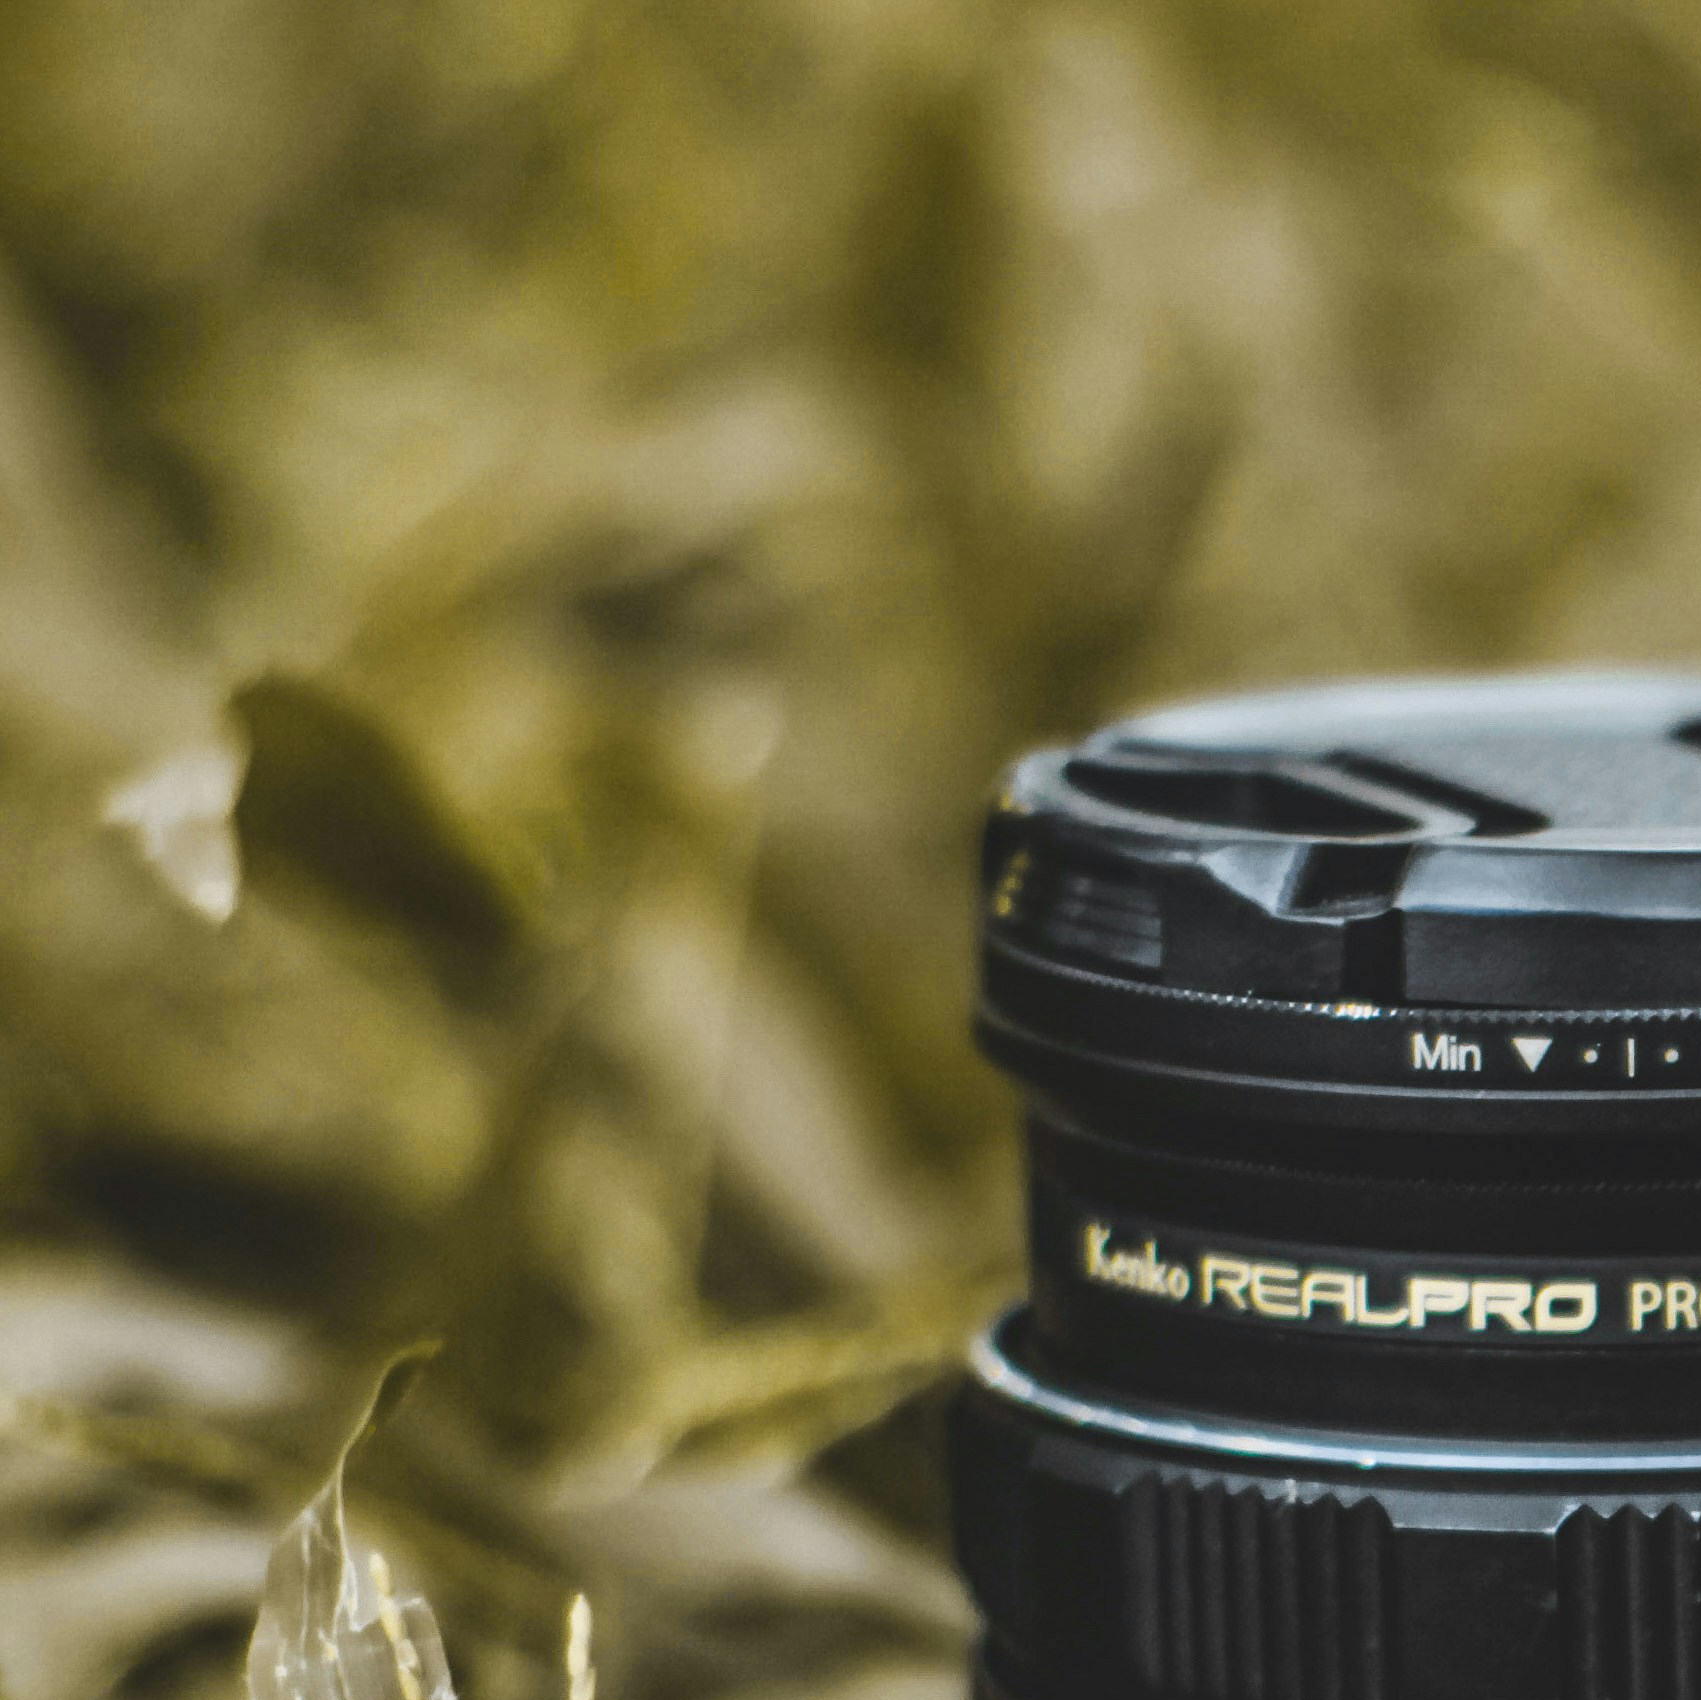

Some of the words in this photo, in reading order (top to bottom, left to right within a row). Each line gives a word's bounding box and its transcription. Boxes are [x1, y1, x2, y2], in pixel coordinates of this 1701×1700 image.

[1410, 1031, 1482, 1072] Min
[1083, 1222, 1192, 1301] Kenko
[1199, 1254, 1597, 1333] REALPRO
